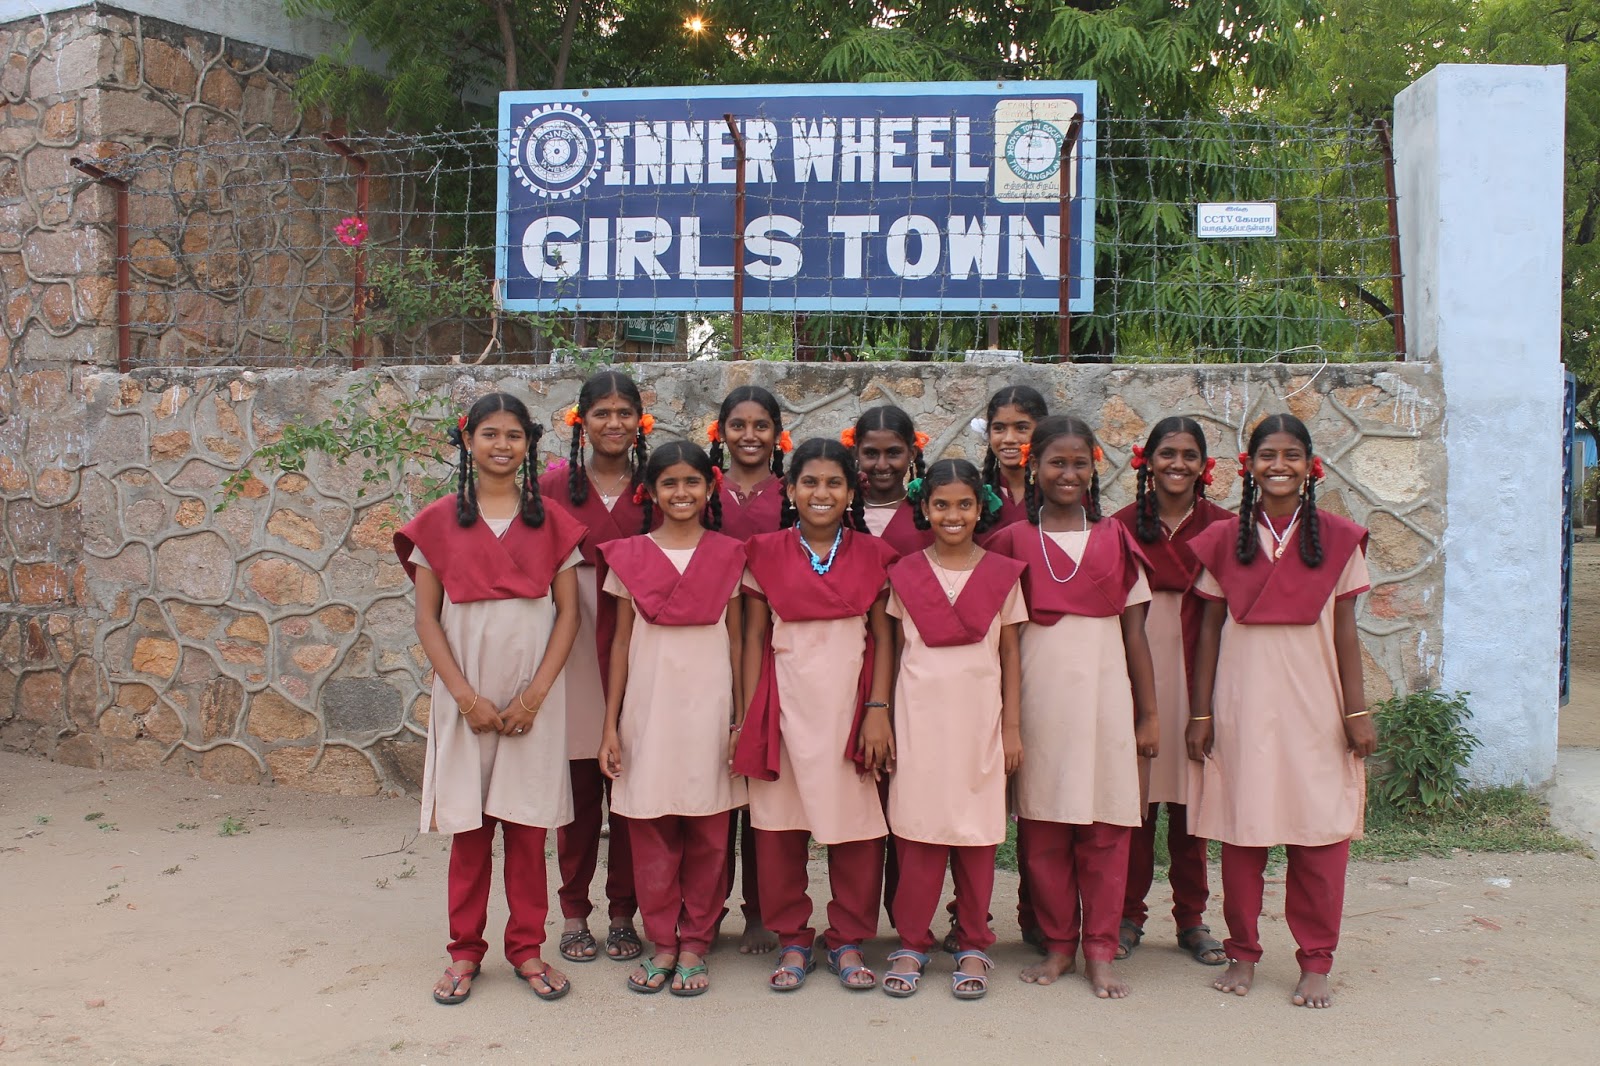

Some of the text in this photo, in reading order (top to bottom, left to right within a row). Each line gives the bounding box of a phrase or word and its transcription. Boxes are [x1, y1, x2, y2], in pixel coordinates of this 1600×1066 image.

[541, 130, 575, 143] INNER
[1007, 131, 1021, 150] BOYS
[604, 116, 990, 185] INNER WHEEL
[540, 159, 575, 173] WHEEL
[1204, 215, 1234, 224] CCTV
[521, 215, 1061, 283] GIRLS TOWN
